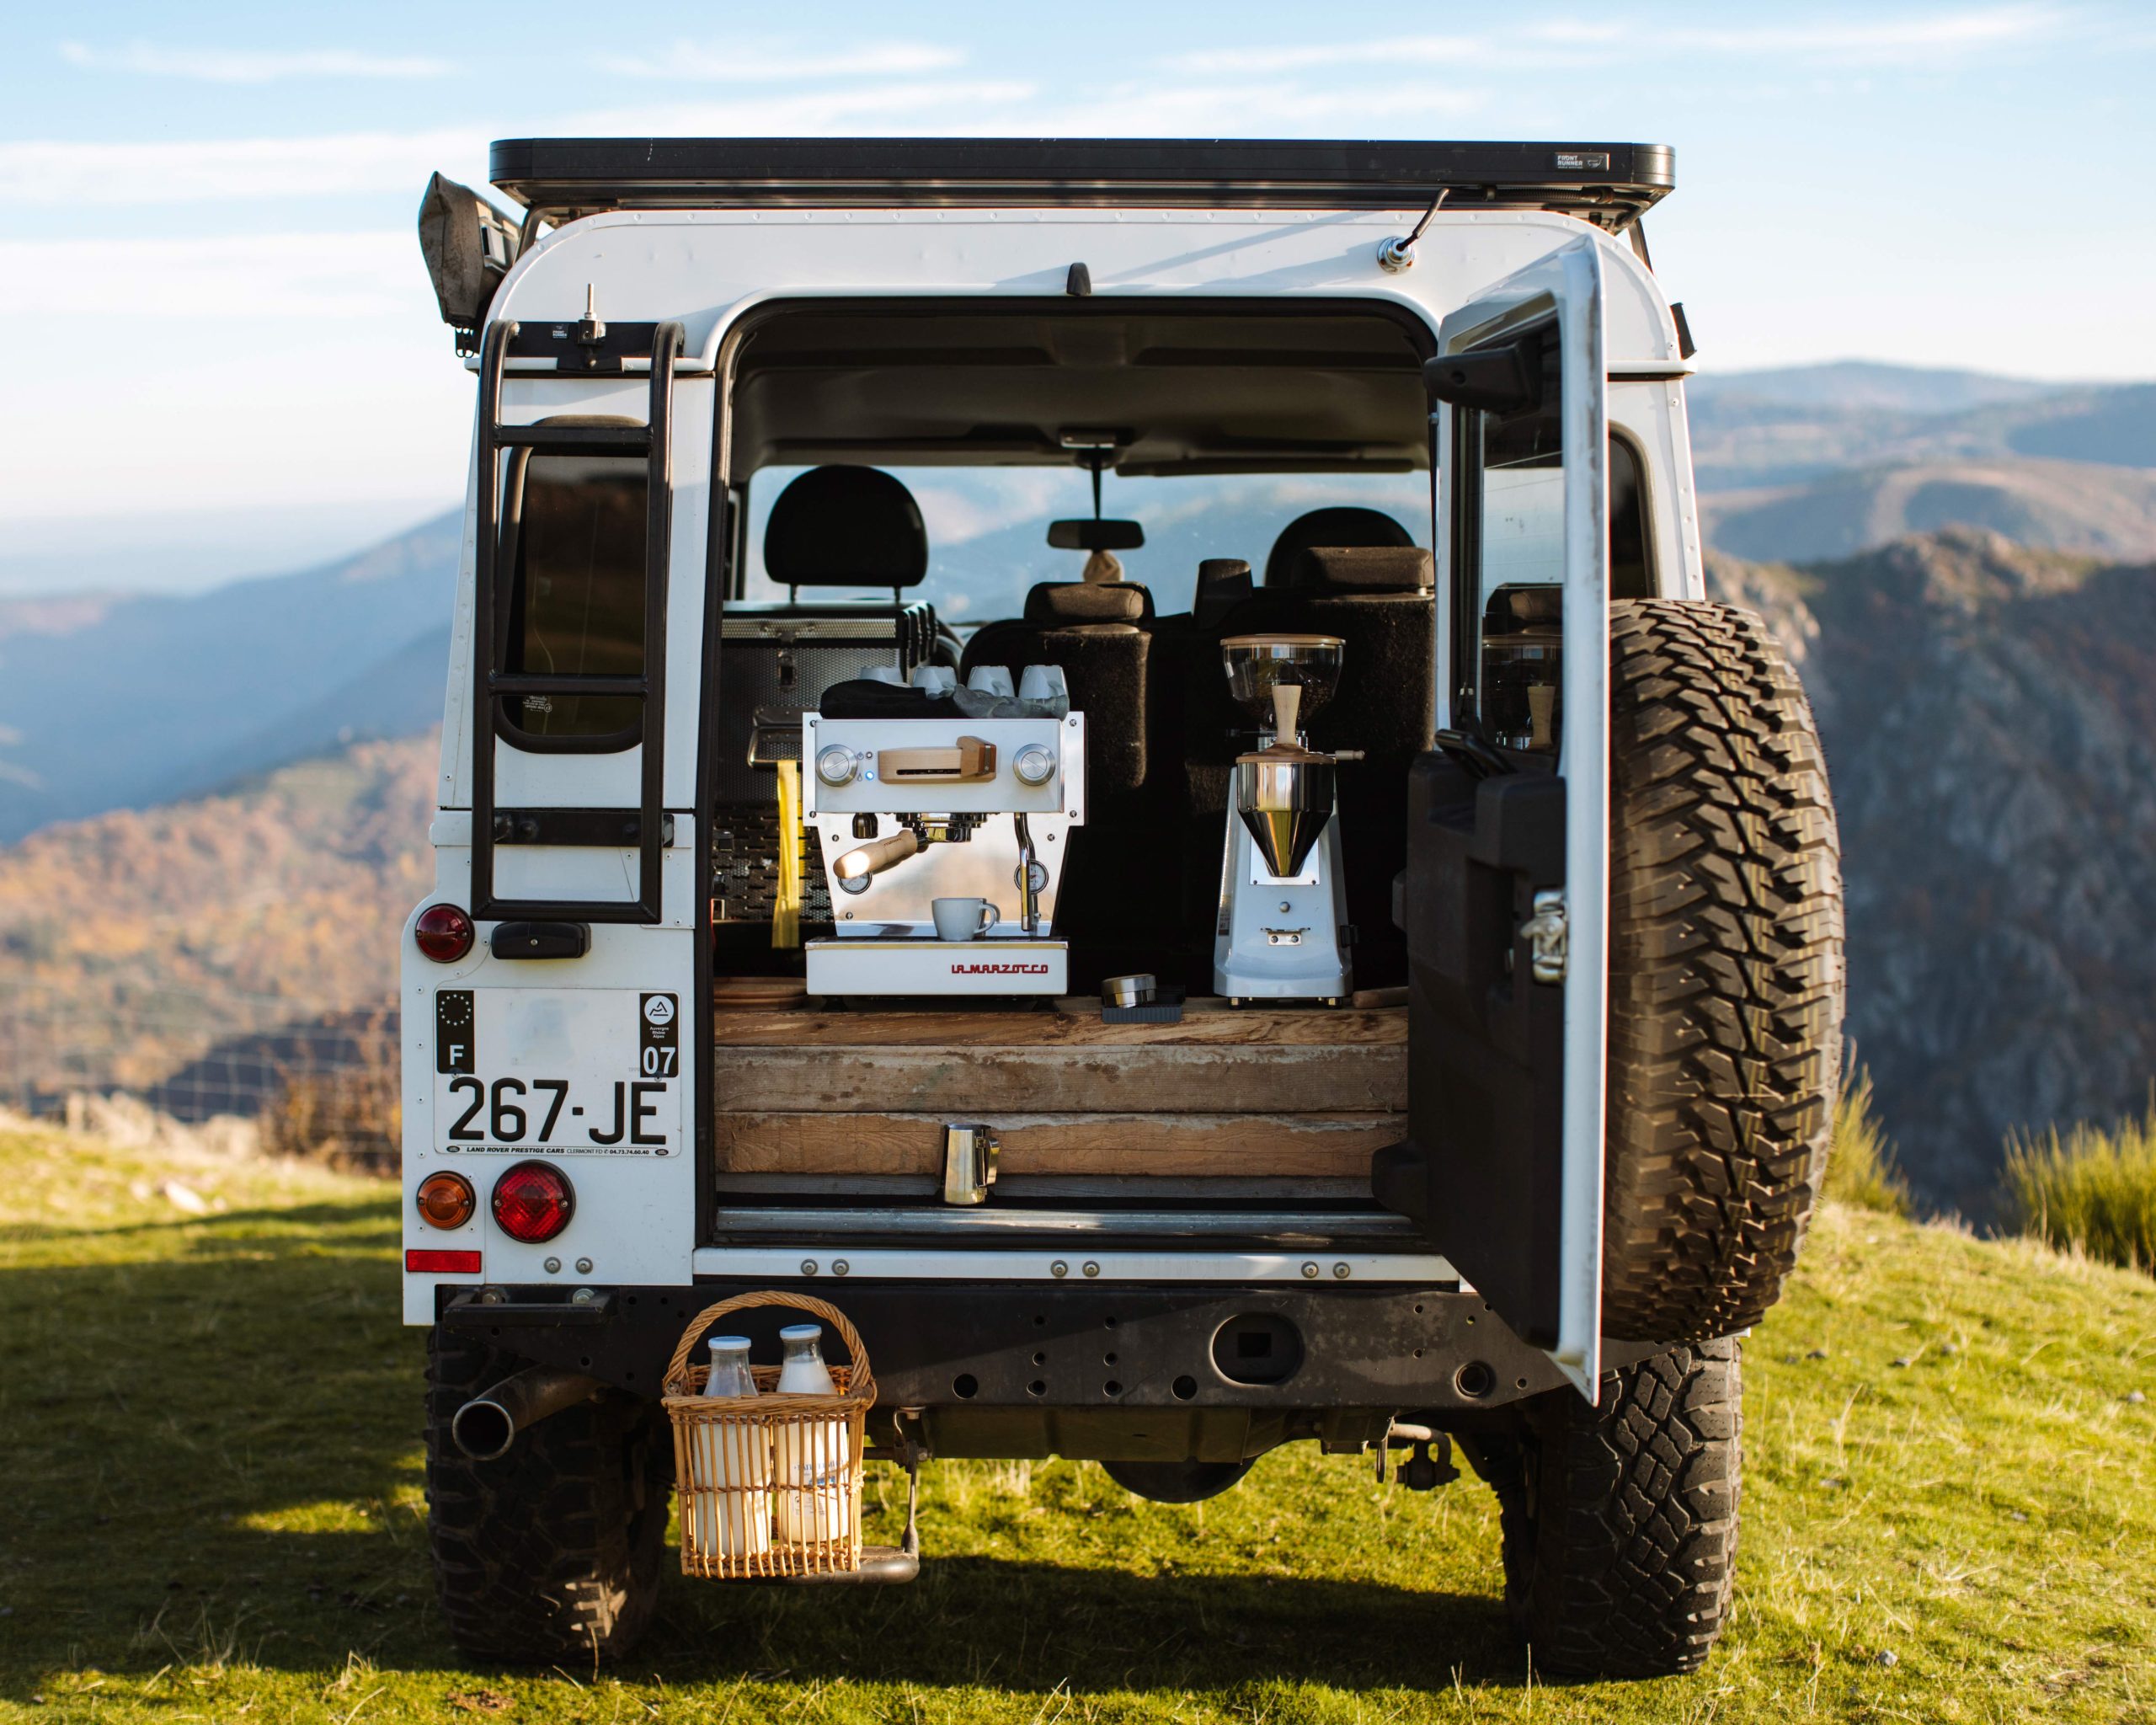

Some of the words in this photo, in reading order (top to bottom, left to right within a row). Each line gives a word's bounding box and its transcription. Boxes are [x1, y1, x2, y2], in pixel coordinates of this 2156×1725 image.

[952, 964, 964, 974] LA
[969, 964, 1049, 974] MARZOCCO
[450, 1044, 464, 1065] F
[643, 1046, 675, 1075] 07
[448, 1076, 667, 1145] 267-JE
